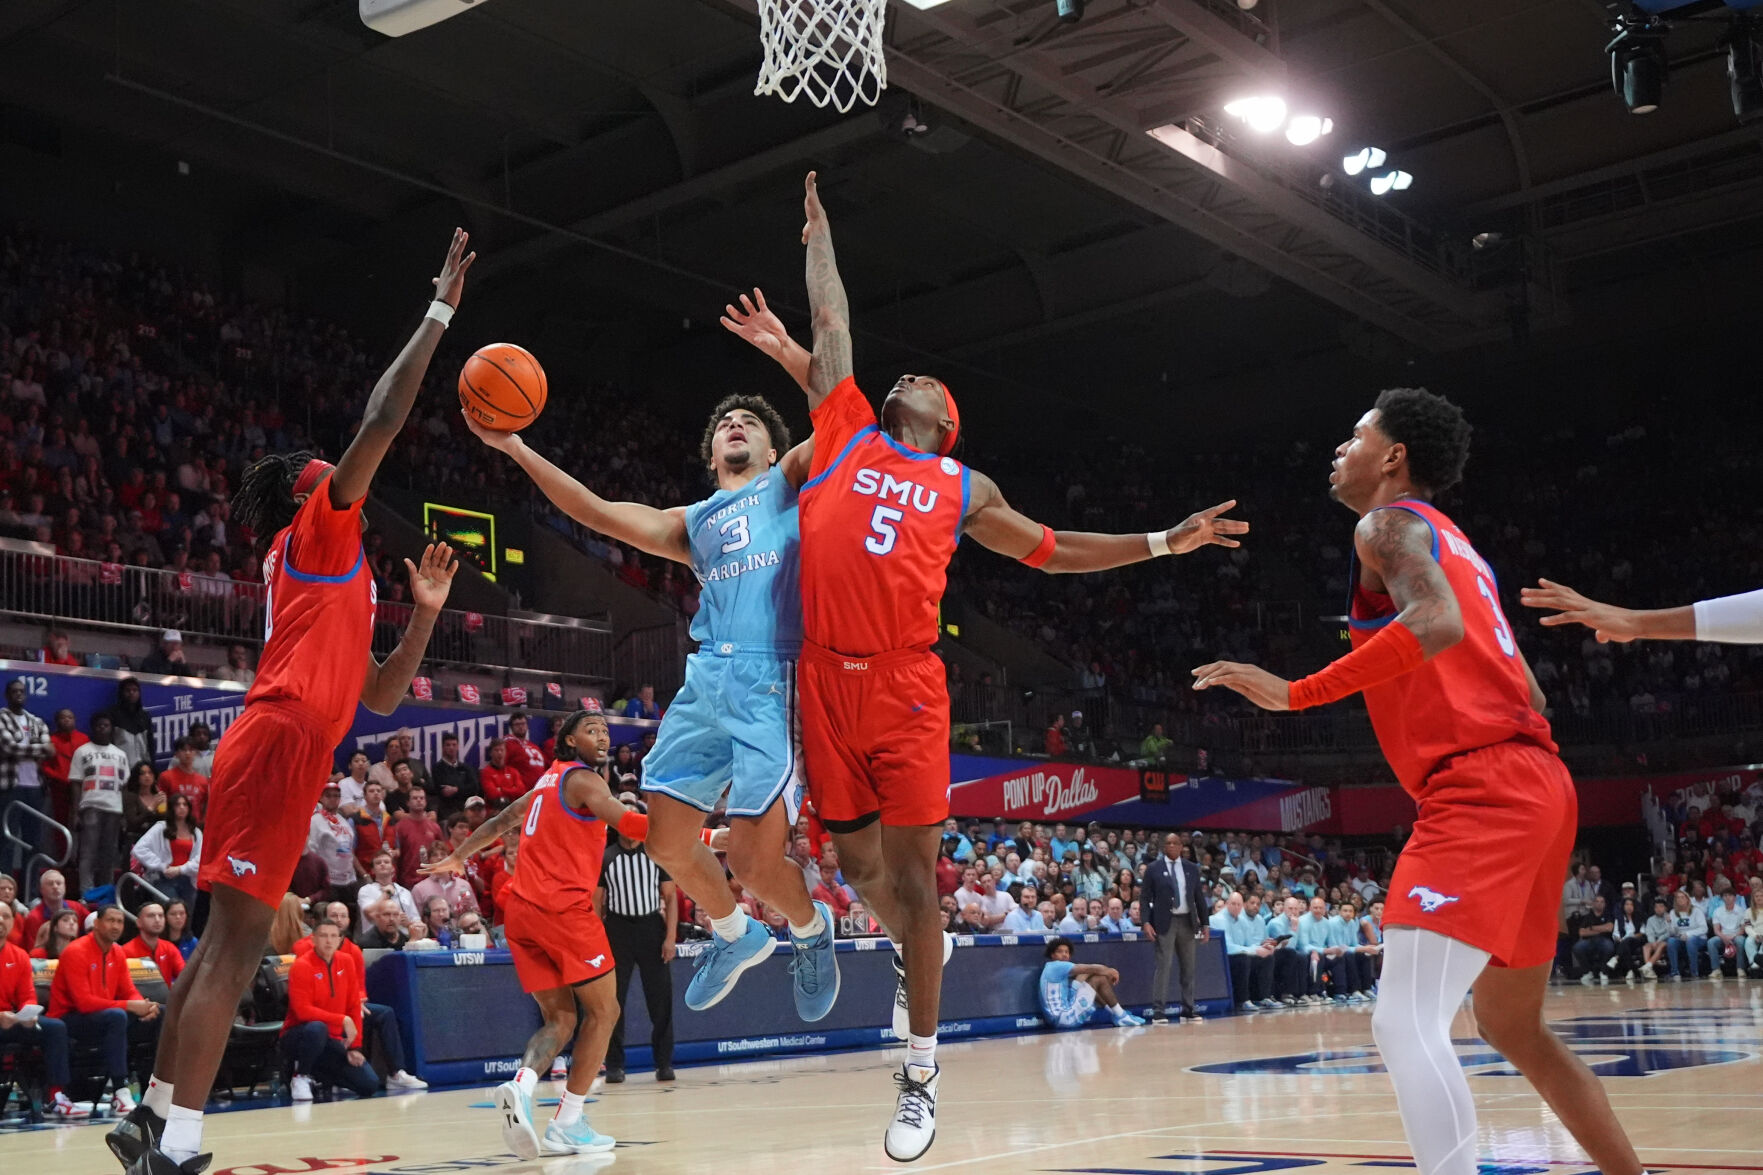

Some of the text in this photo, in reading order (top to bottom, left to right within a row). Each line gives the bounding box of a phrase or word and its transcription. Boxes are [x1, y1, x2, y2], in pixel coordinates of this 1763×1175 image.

[852, 468, 938, 513] SMU
[706, 494, 760, 530] NORTH
[864, 504, 903, 556] 5
[719, 514, 752, 555] 3
[707, 549, 781, 581] AROLINA
[1476, 574, 1516, 658] 3
[843, 661, 868, 671] SMU
[173, 694, 193, 711] THE
[1003, 767, 1098, 815] PONY UP Dallas
[1279, 786, 1332, 832] MUSTANGS
[525, 793, 544, 836] 0
[453, 952, 485, 966] UTSW
[855, 940, 876, 951] UTSW
[955, 936, 975, 948] UTSW
[780, 1036, 804, 1046] Medical
[805, 1035, 826, 1045] Center
